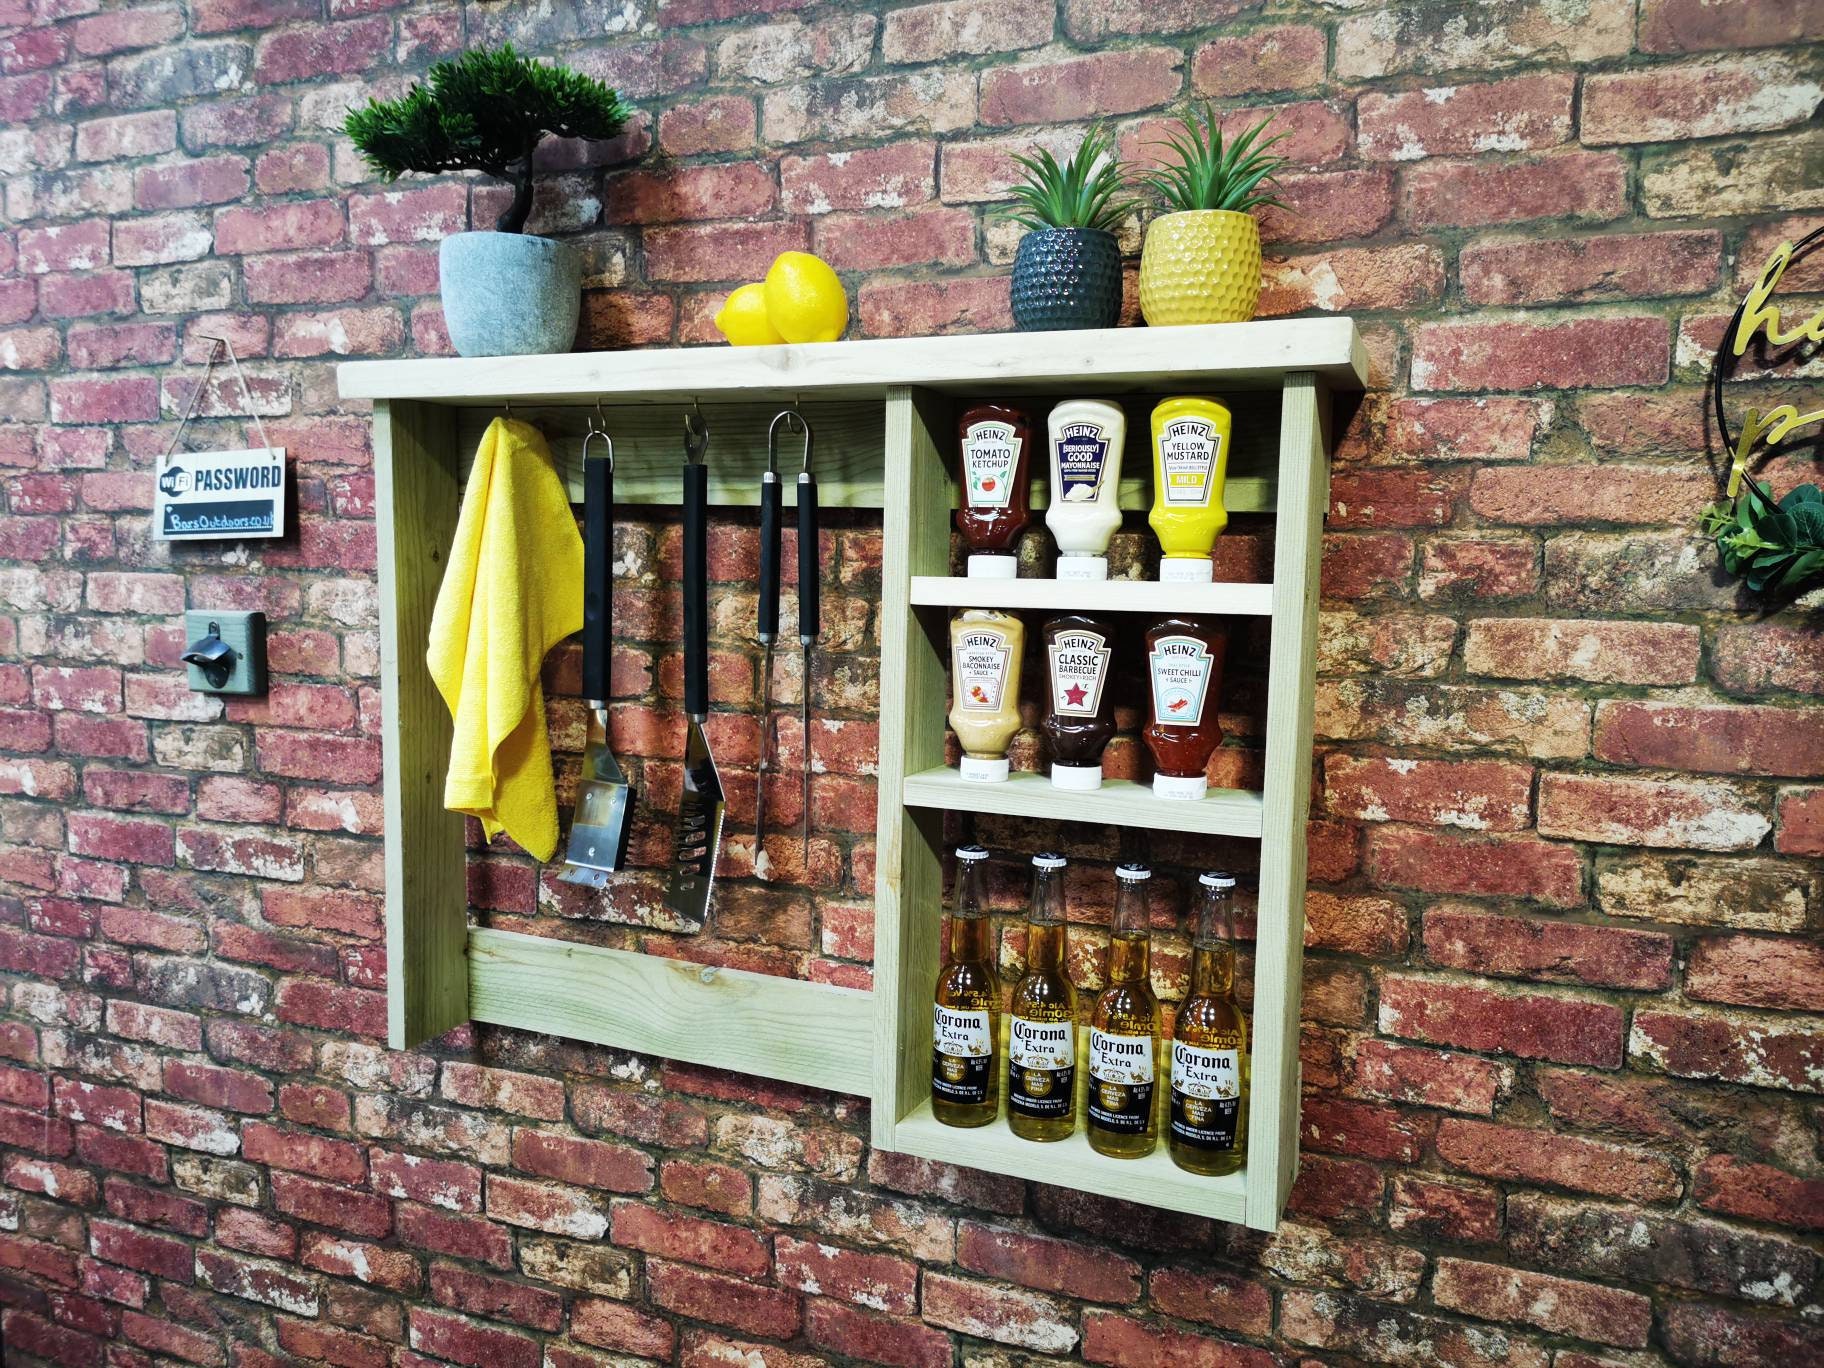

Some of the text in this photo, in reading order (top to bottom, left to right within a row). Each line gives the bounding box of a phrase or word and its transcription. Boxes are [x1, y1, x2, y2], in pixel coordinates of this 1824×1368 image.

[975, 429, 1006, 441] HEINZ
[1065, 426, 1098, 439] HEINZ
[1172, 425, 1206, 437] HEINZ
[1171, 442, 1206, 451] YELLOW
[970, 449, 1011, 459] TOMATO
[1067, 452, 1093, 462] GOOD
[1166, 452, 1210, 461] MUSTARD
[972, 460, 1009, 468] KETCHUP
[195, 466, 281, 491] PASSWORD
[1176, 475, 1198, 485] MILD
[966, 636, 997, 648] HEINZ
[1063, 638, 1095, 651] HEINZ
[1163, 644, 1197, 657] HEINZ
[968, 655, 994, 663] SMOKEY
[1058, 654, 1099, 666] CLASSIC
[1058, 664, 1097, 675] BARBECUE
[1157, 668, 1202, 677] SWEET CHILLI
[934, 1007, 981, 1029] Corona
[942, 1026, 969, 1040] Extra
[1014, 1021, 1066, 1041] Corona
[1025, 1040, 1055, 1054] Extra
[1092, 1032, 1144, 1055] Corona
[1101, 1051, 1132, 1068] Extra
[1175, 1044, 1230, 1069] Corona
[1186, 1066, 1218, 1082] Extra
